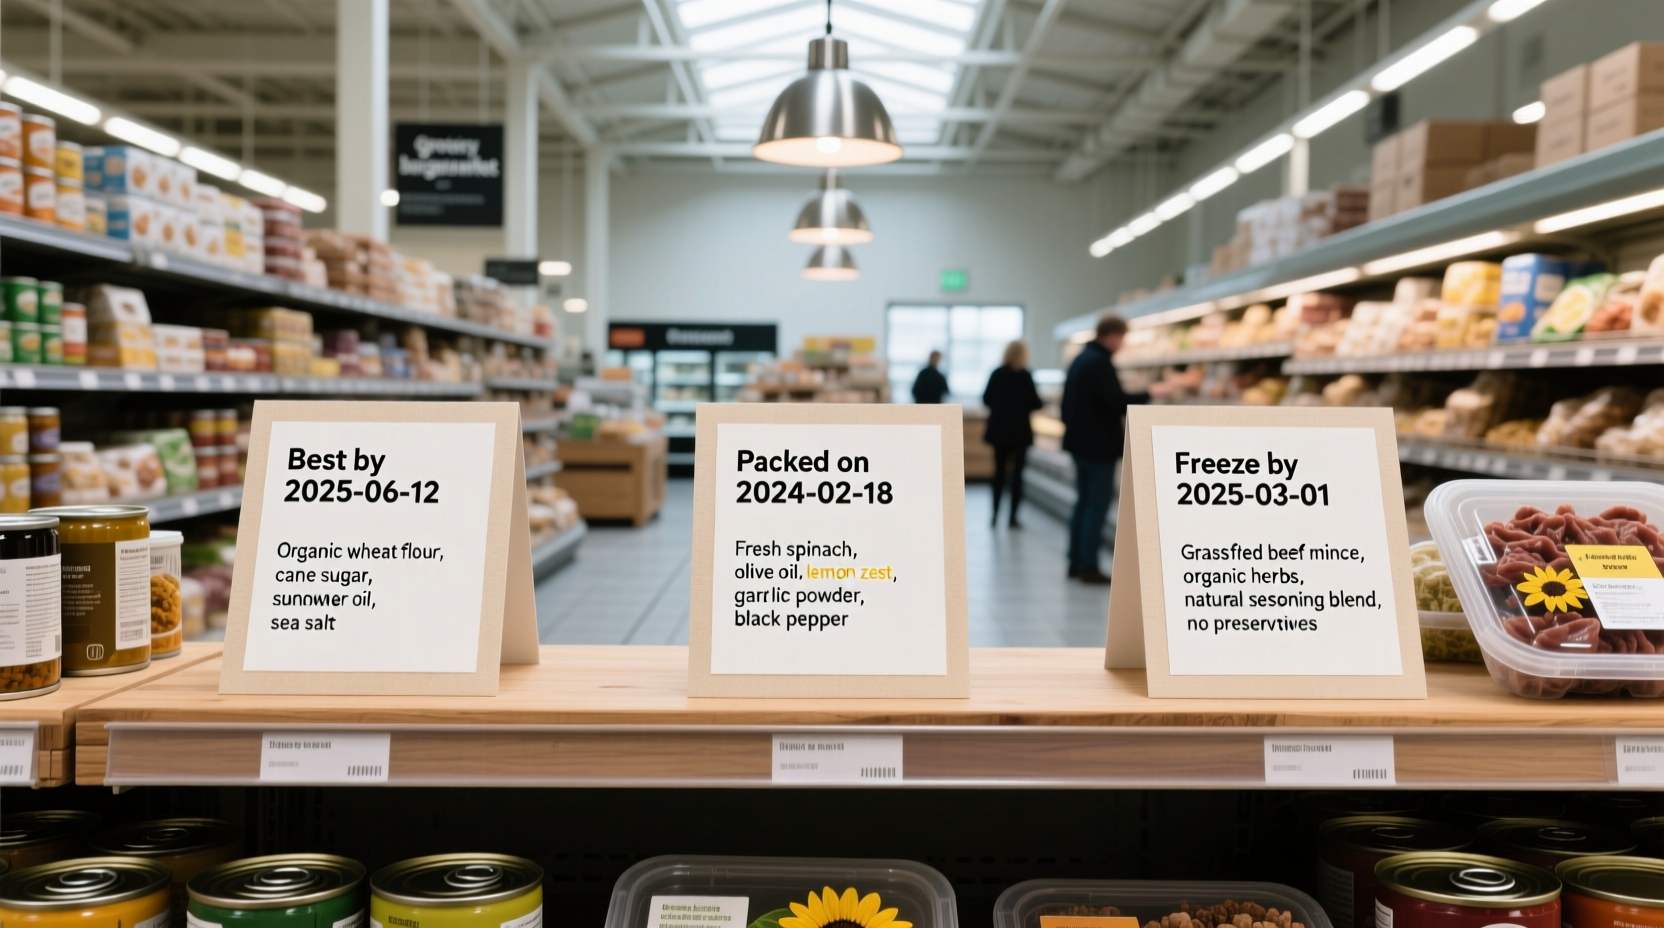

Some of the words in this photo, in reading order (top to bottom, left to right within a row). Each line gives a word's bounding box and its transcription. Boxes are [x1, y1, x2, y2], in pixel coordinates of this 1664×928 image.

[287, 447, 348, 471] Best
[353, 447, 386, 478] by
[737, 449, 829, 473] Packed
[836, 455, 869, 473] on
[1175, 451, 1261, 475] Freeze
[1267, 450, 1299, 481] by
[283, 478, 440, 504] 2025-06-12
[735, 479, 894, 505] 2024-02-18
[1176, 482, 1329, 507] 2025-03-01
[277, 541, 343, 564] Organic
[347, 541, 398, 560] wheat
[400, 541, 444, 562] flour,
[735, 540, 782, 558] Fresh
[786, 540, 858, 562] spinach,
[1267, 542, 1306, 561] beef
[1309, 543, 1365, 564] mince,
[275, 570, 317, 583] cane
[320, 570, 373, 587] sugar,
[734, 562, 774, 580] olive
[778, 563, 803, 581] oil,
[806, 563, 856, 580] lemon
[860, 564, 897, 583] zest,
[1183, 566, 1247, 589] organic
[1251, 566, 1304, 586] herbs,
[352, 590, 376, 610] oil,
[796, 586, 865, 609] powder,
[1184, 589, 1243, 608] natural
[1248, 589, 1325, 612] sesoning
[1328, 589, 1382, 610] blend,
[270, 617, 300, 631] sea
[304, 613, 337, 631] salt
[734, 609, 781, 627] black
[786, 613, 849, 632] pepper
[1187, 618, 1209, 631] no
